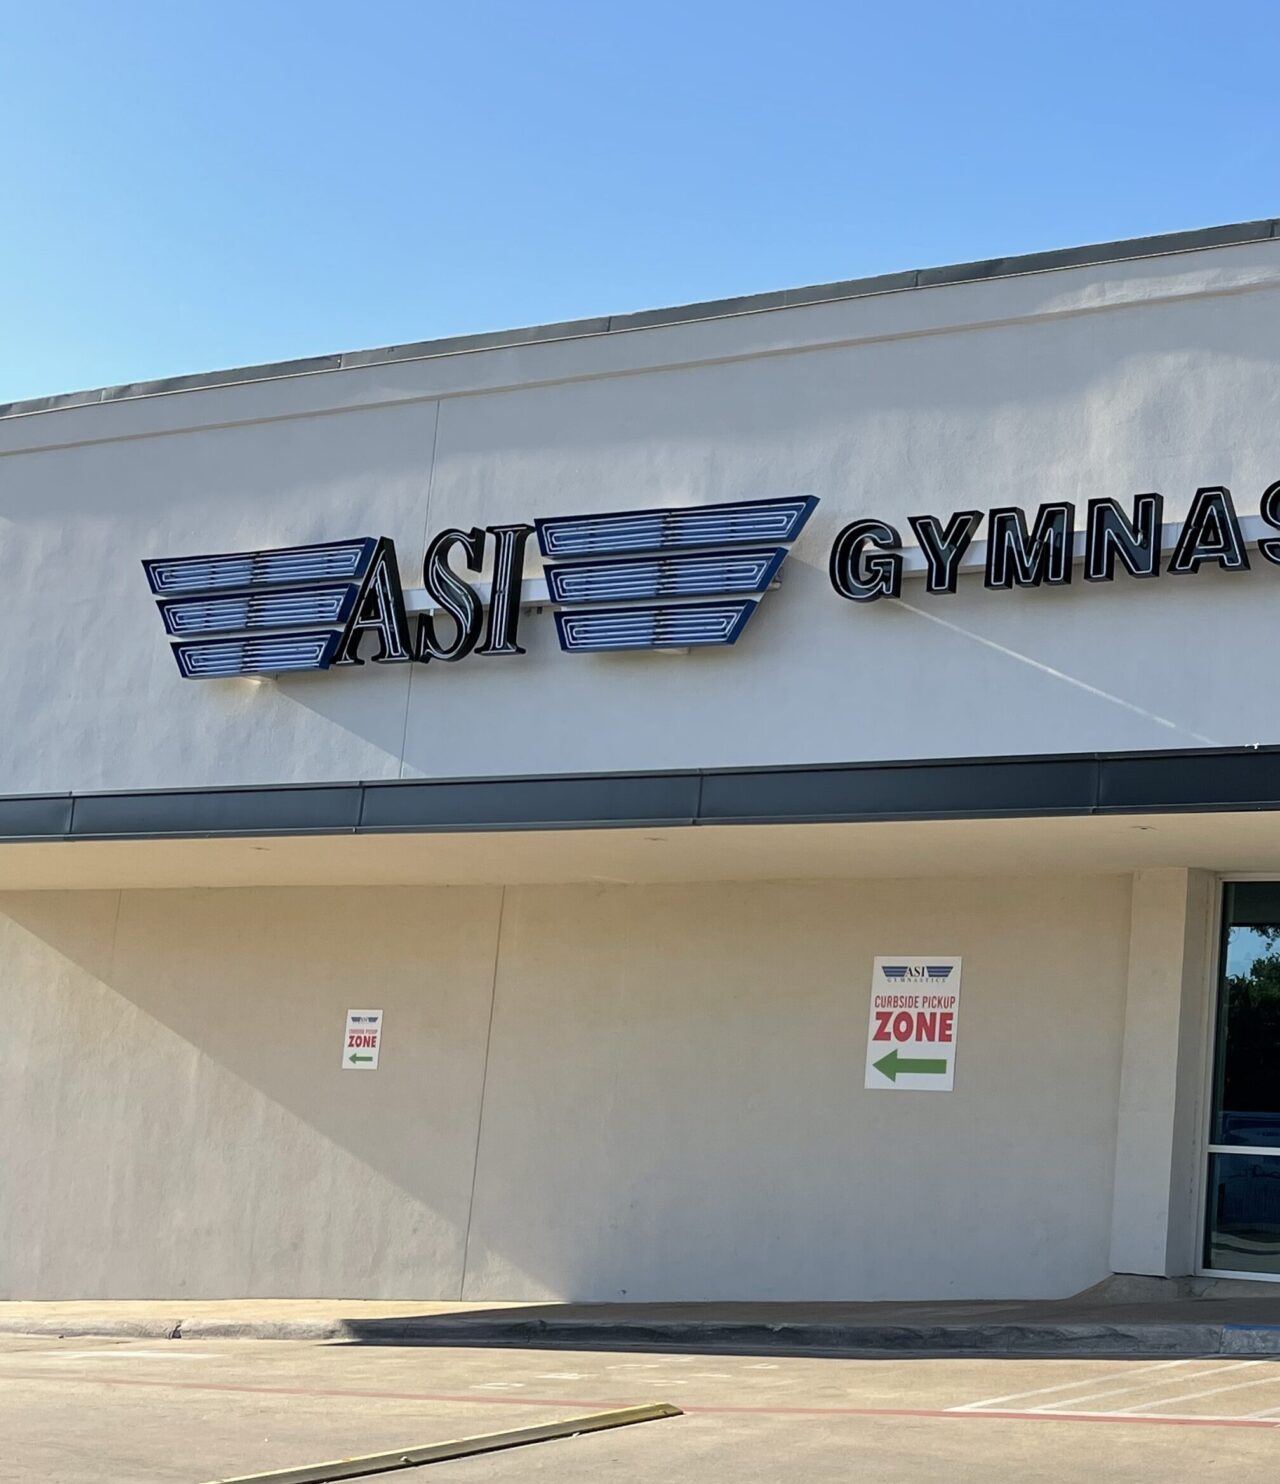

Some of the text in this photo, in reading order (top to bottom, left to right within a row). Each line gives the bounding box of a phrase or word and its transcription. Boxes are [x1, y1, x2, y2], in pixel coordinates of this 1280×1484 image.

[328, 523, 536, 665] ASI
[905, 966, 926, 978] ASI
[874, 995, 956, 1009] CURBSIDE PICKUP
[872, 1011, 954, 1042] ZONE
[348, 1035, 377, 1048] ZONE
